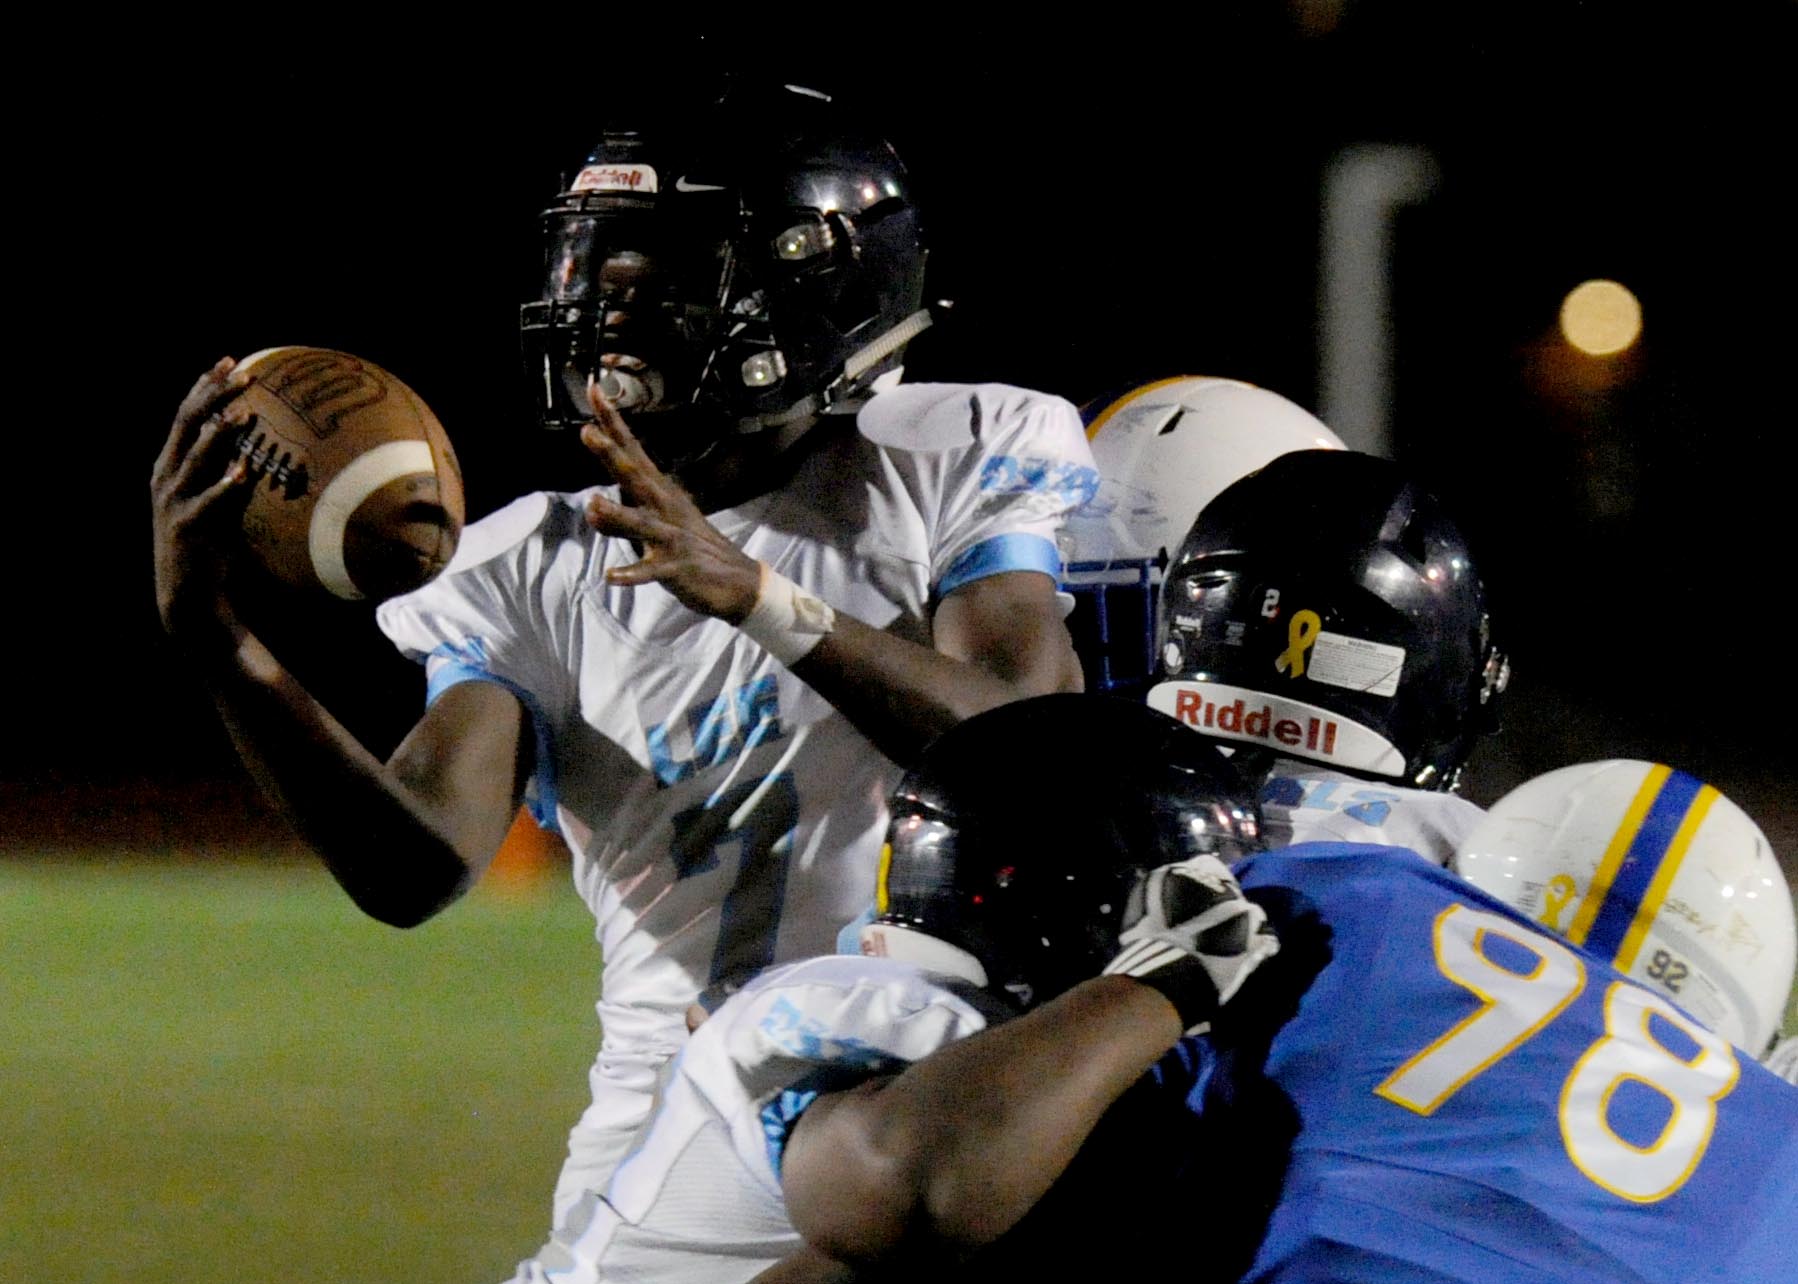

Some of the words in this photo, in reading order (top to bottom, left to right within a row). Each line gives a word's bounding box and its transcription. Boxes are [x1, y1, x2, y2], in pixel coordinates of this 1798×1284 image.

[1175, 688, 1338, 756] Riddell
[668, 769, 799, 1010] 7
[1646, 949, 1689, 994] 92
[1372, 902, 1741, 1205] 98
